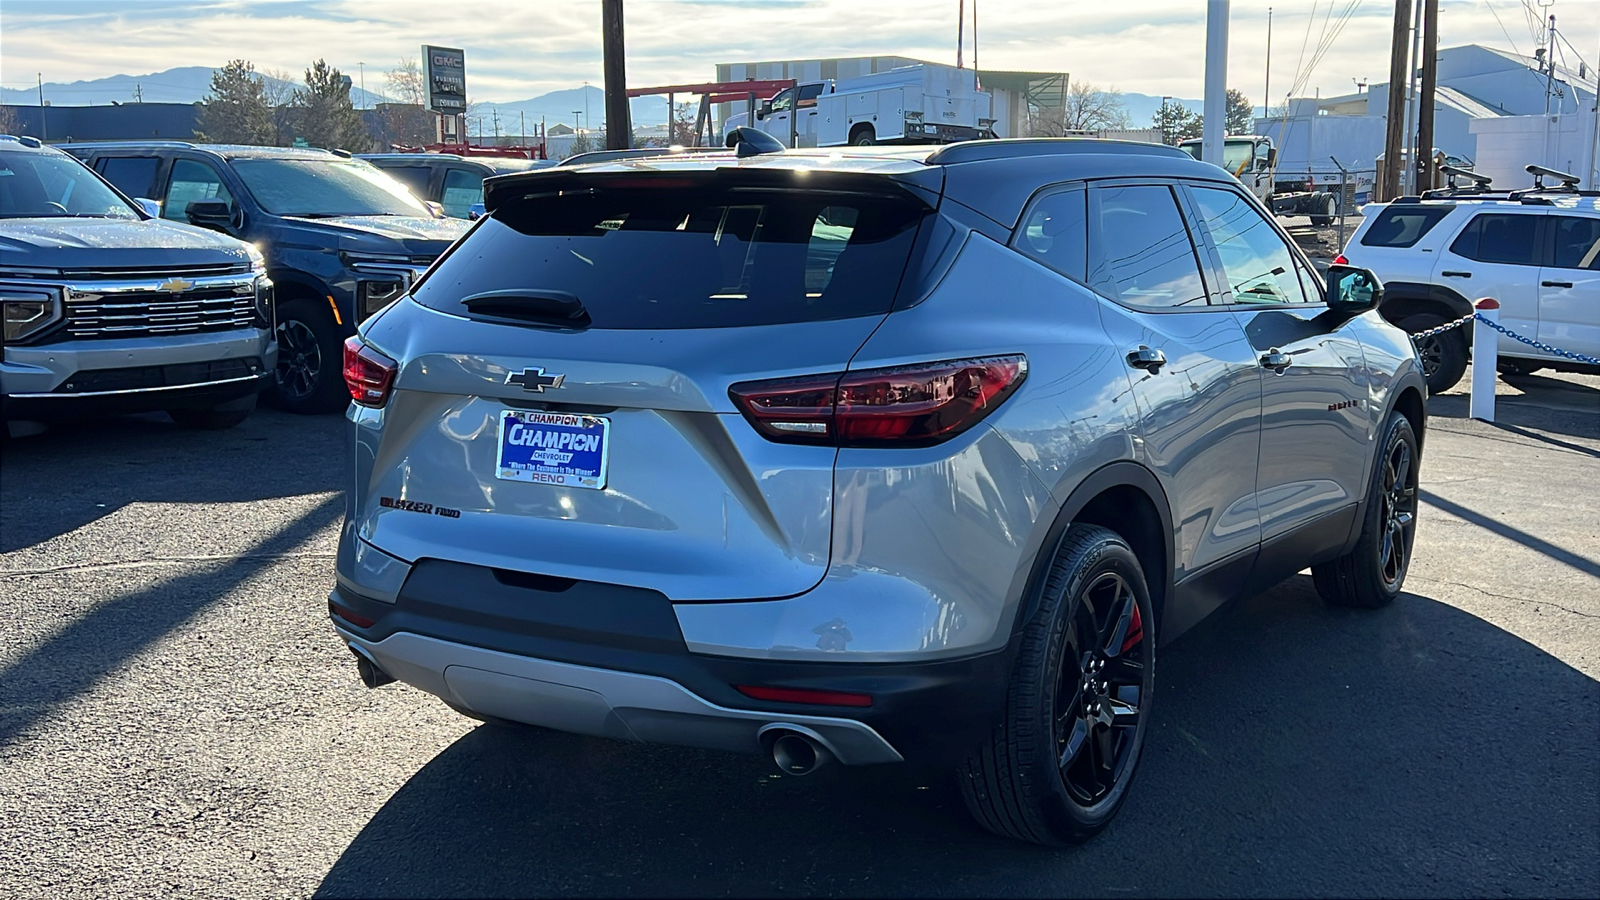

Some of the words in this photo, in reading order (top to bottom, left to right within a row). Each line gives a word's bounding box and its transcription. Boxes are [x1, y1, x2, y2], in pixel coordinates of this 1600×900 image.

[433, 56, 462, 68] GMC
[435, 75, 461, 84] BUSINESS
[528, 413, 578, 426] CHAMPION
[508, 423, 600, 452] CHAMPION
[534, 451, 570, 461] CHEVROLET
[536, 464, 559, 473] Customer
[565, 467, 575, 475] The
[532, 472, 565, 484] RENO
